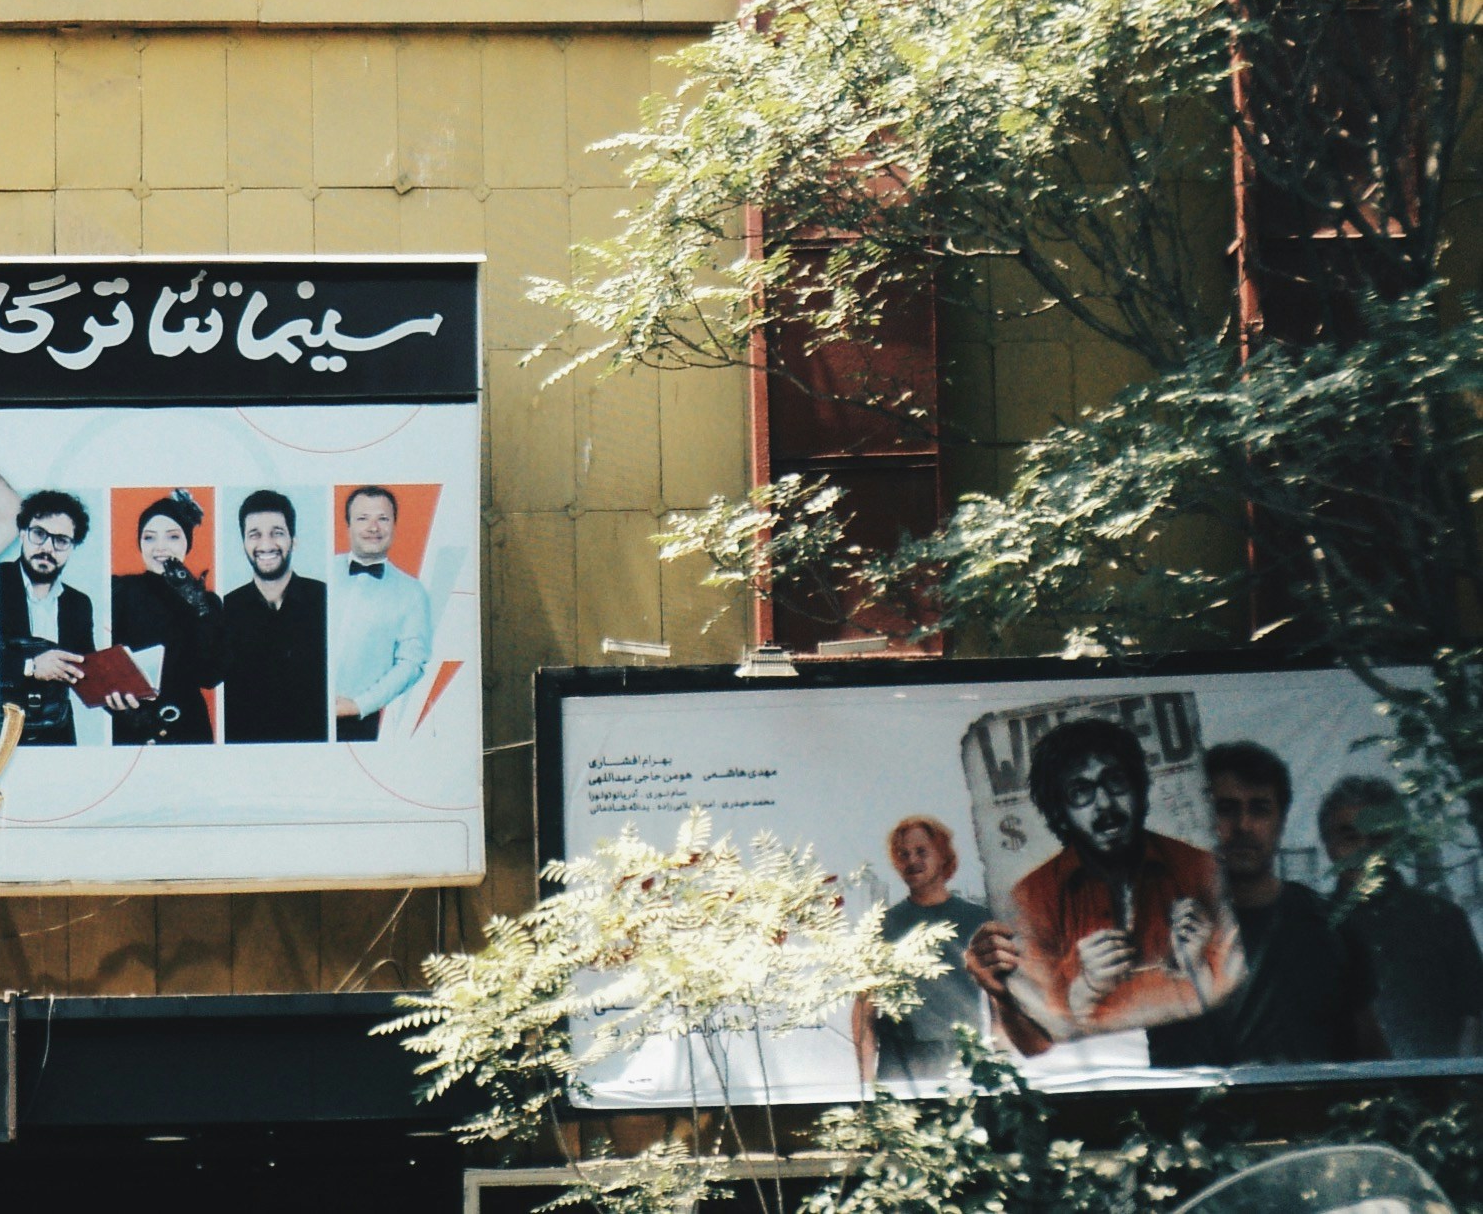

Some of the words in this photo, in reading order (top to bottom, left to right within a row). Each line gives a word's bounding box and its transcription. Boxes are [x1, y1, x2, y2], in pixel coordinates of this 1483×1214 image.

[236, 280, 444, 372] سینما
[977, 692, 1195, 796] WED
[588, 754, 641, 770] افشاری
[642, 754, 673, 768] بهرام
[663, 771, 693, 784] هومن
[702, 767, 747, 782] هاشمی
